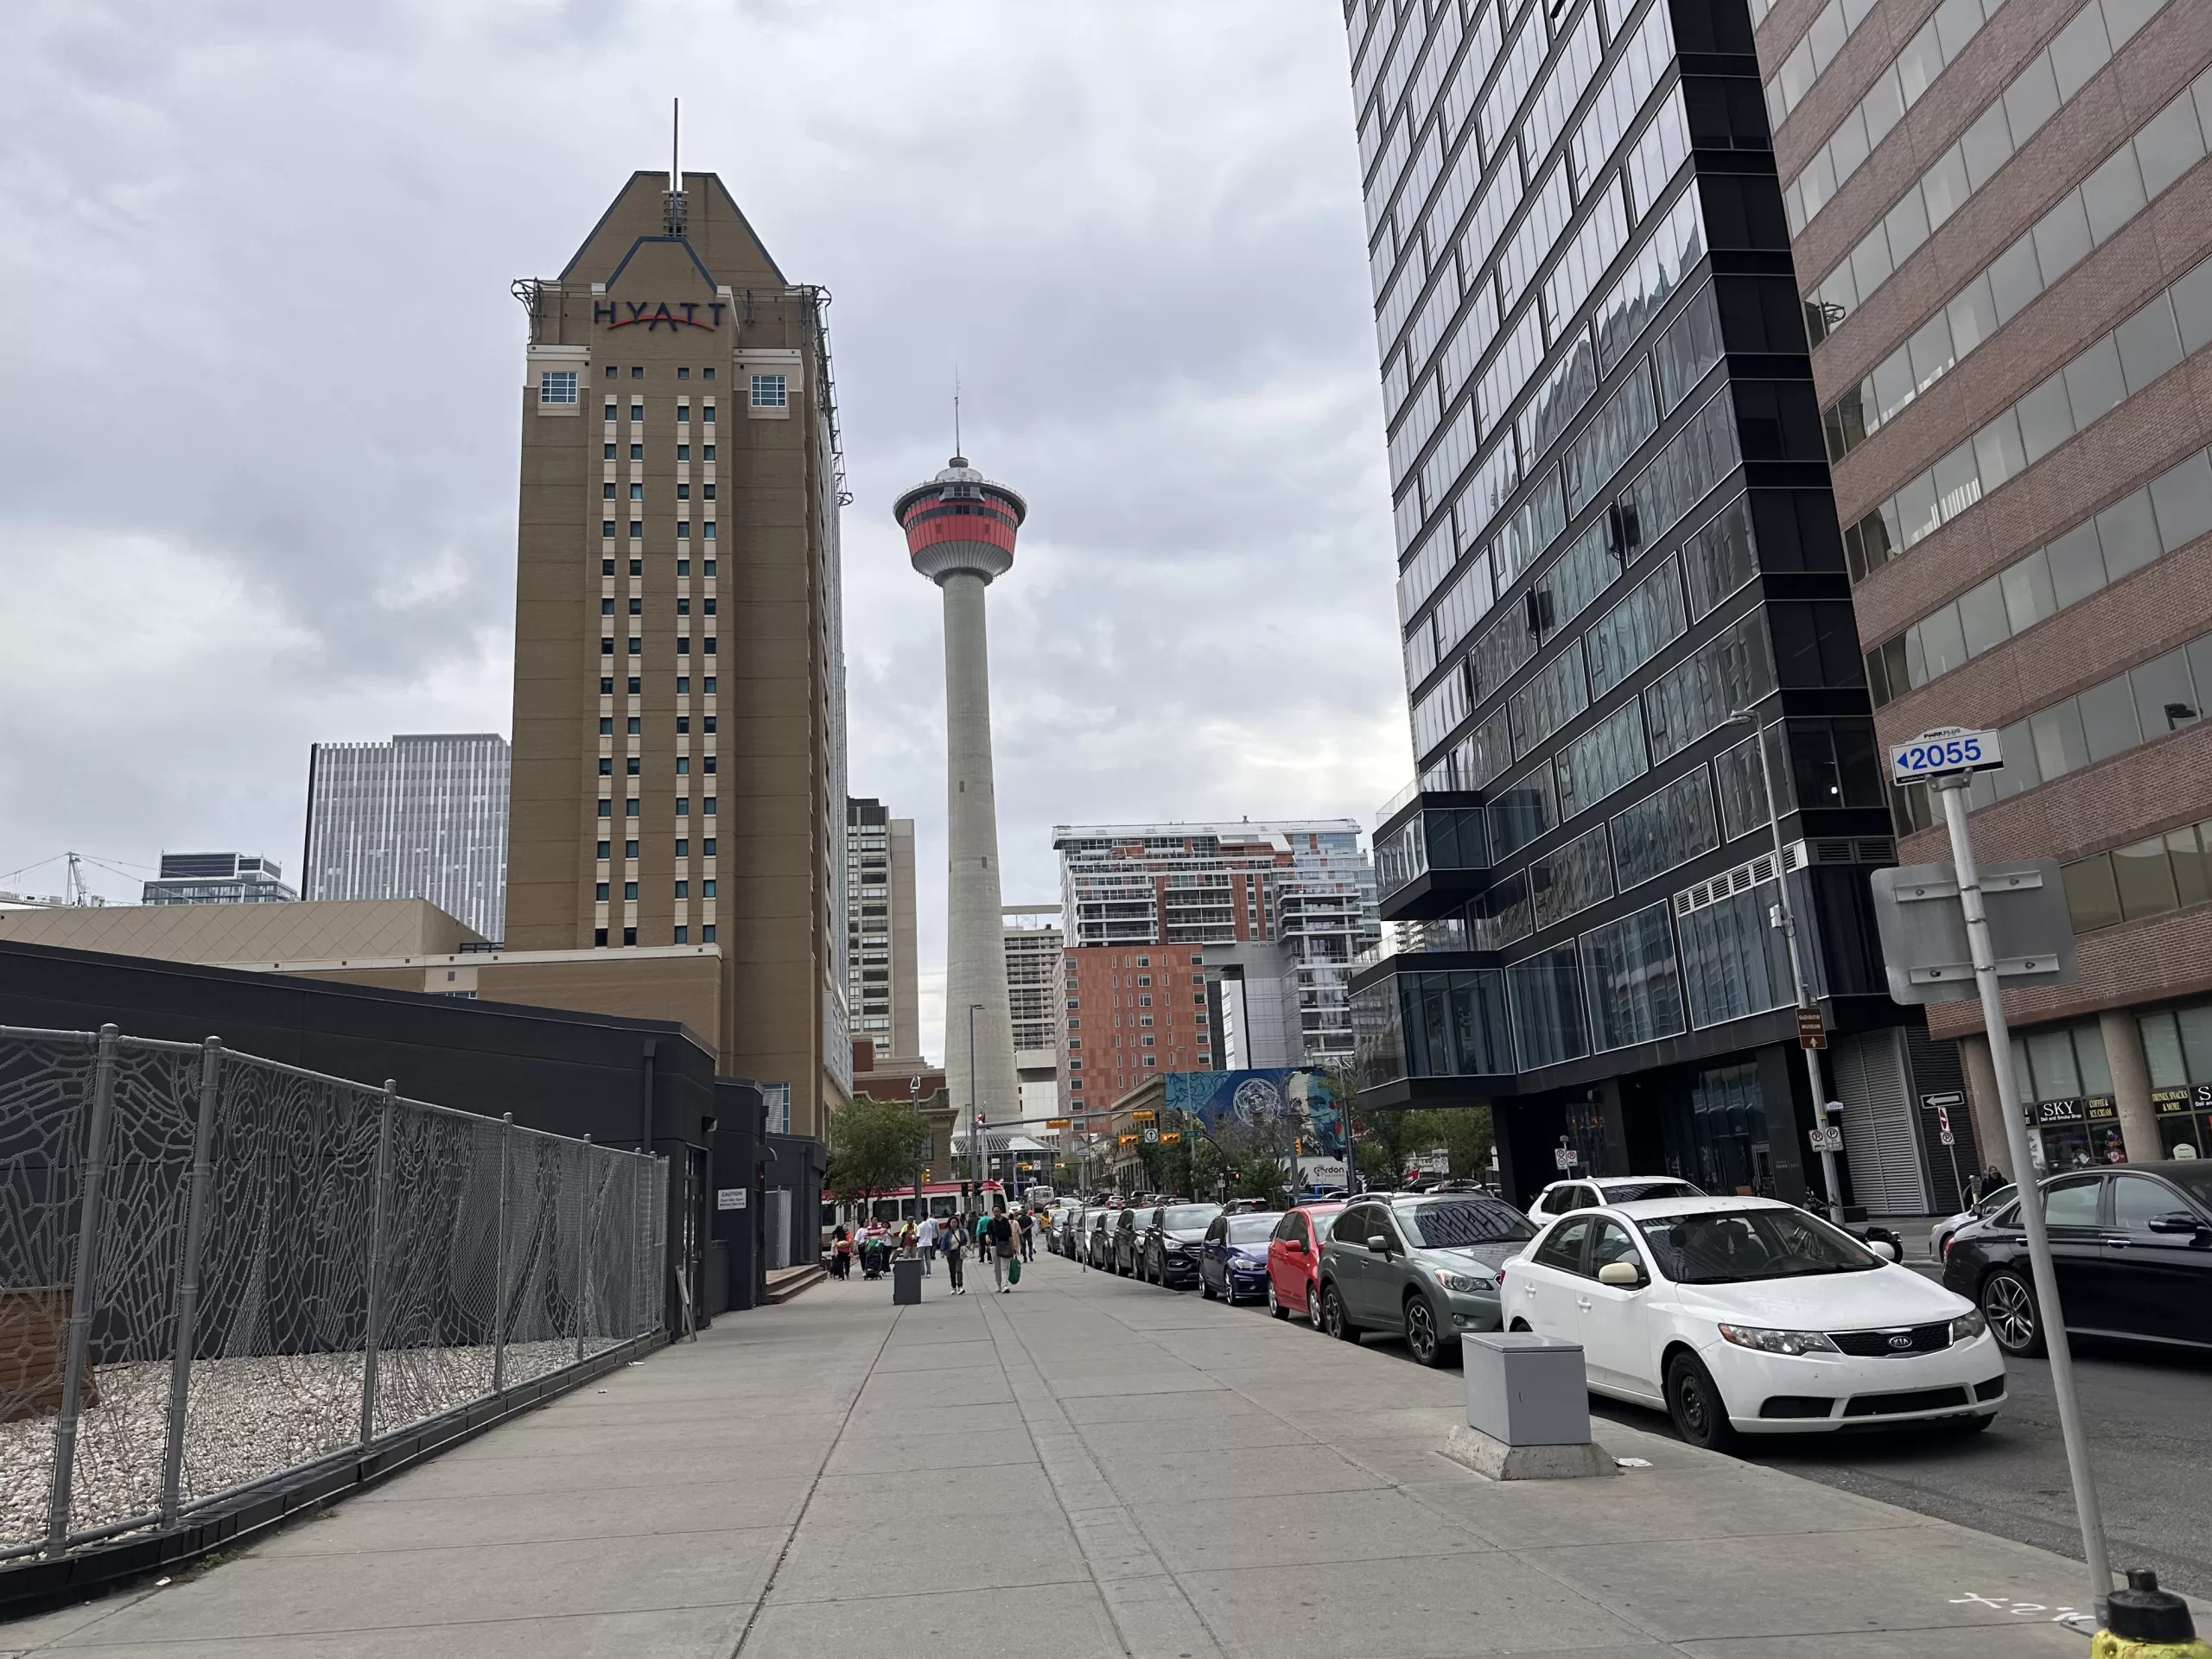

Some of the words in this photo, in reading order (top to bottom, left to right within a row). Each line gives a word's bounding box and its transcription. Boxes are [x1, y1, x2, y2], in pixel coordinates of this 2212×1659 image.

[594, 301, 726, 331] HYATT
[1910, 739, 1981, 771] 2055
[2170, 1090, 2188, 1100] SNACKS
[2043, 1101, 2074, 1116] SKY
[2089, 1098, 2105, 1108] COFFEE
[2097, 1108, 2113, 1117] CREAM
